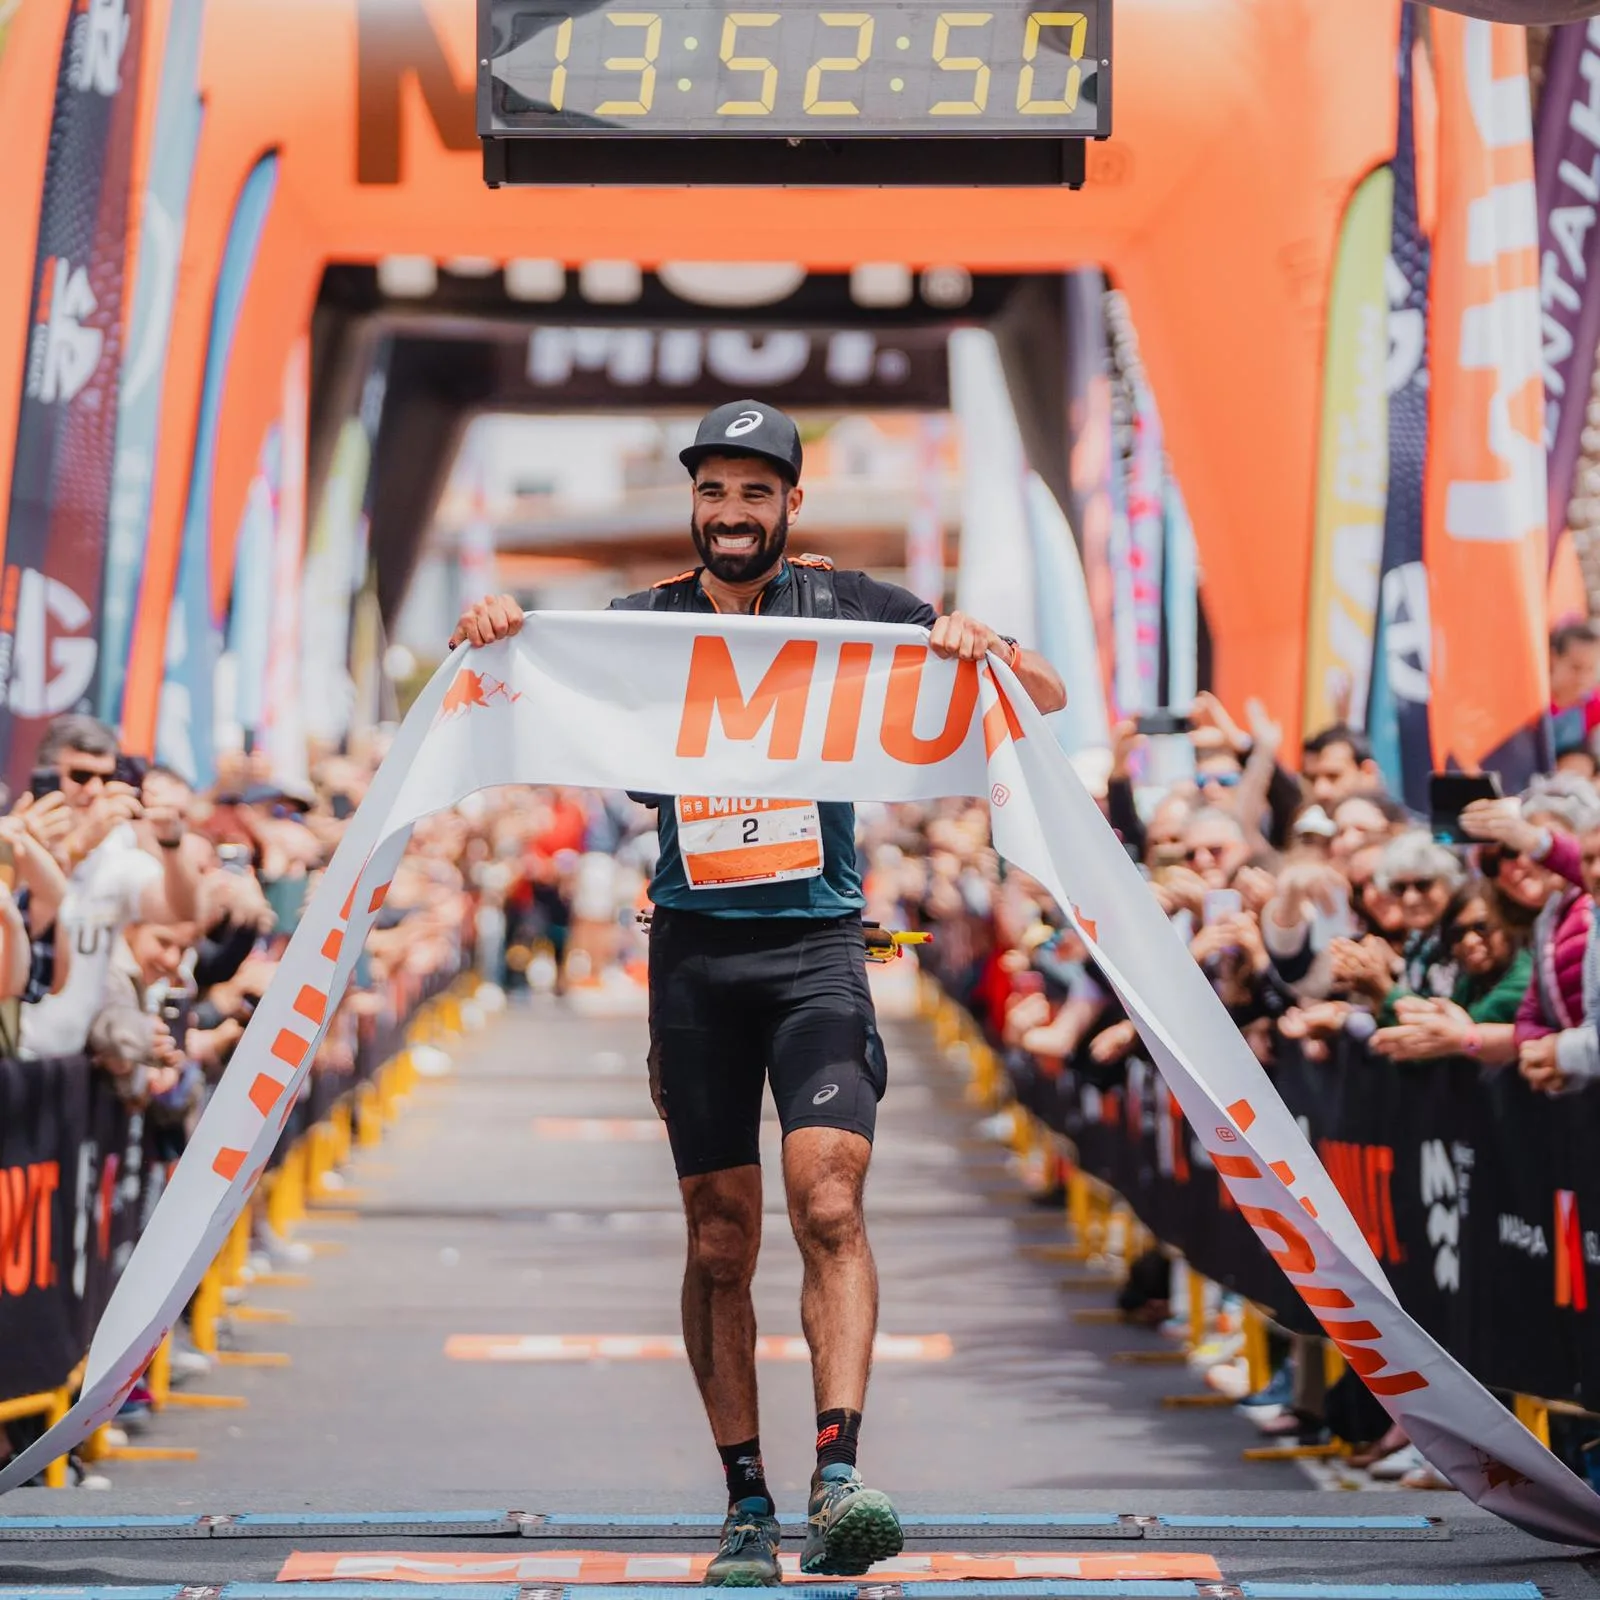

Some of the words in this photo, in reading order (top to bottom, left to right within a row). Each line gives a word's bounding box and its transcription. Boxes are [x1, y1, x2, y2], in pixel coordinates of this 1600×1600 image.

[548, 12, 1088, 114] 13:52:50
[676, 635, 1000, 765] MIU
[742, 818, 759, 843] 2
